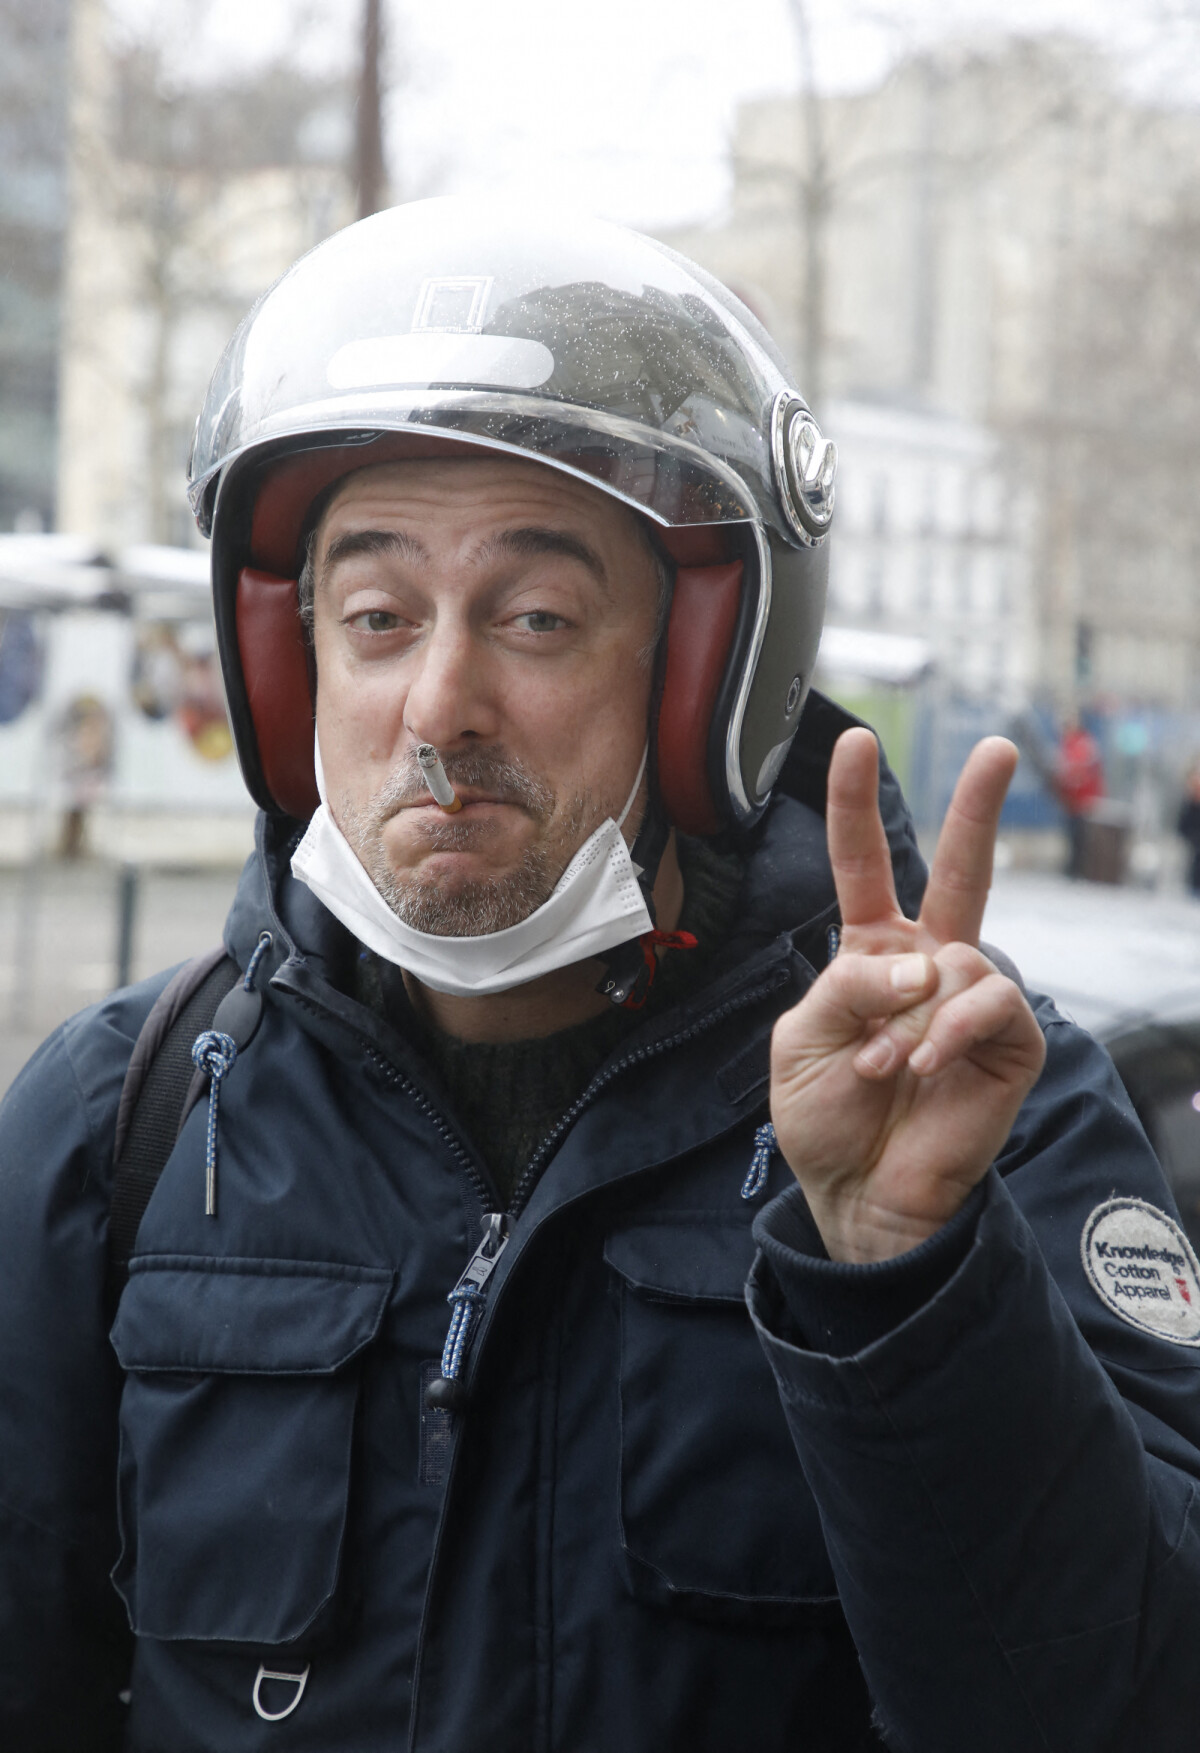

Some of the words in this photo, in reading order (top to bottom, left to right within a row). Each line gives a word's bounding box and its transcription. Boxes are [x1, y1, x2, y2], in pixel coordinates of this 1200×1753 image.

[1095, 1242, 1185, 1268] Knowledge
[1104, 1262, 1161, 1280] Cotton
[1114, 1281, 1172, 1301] Apparel
